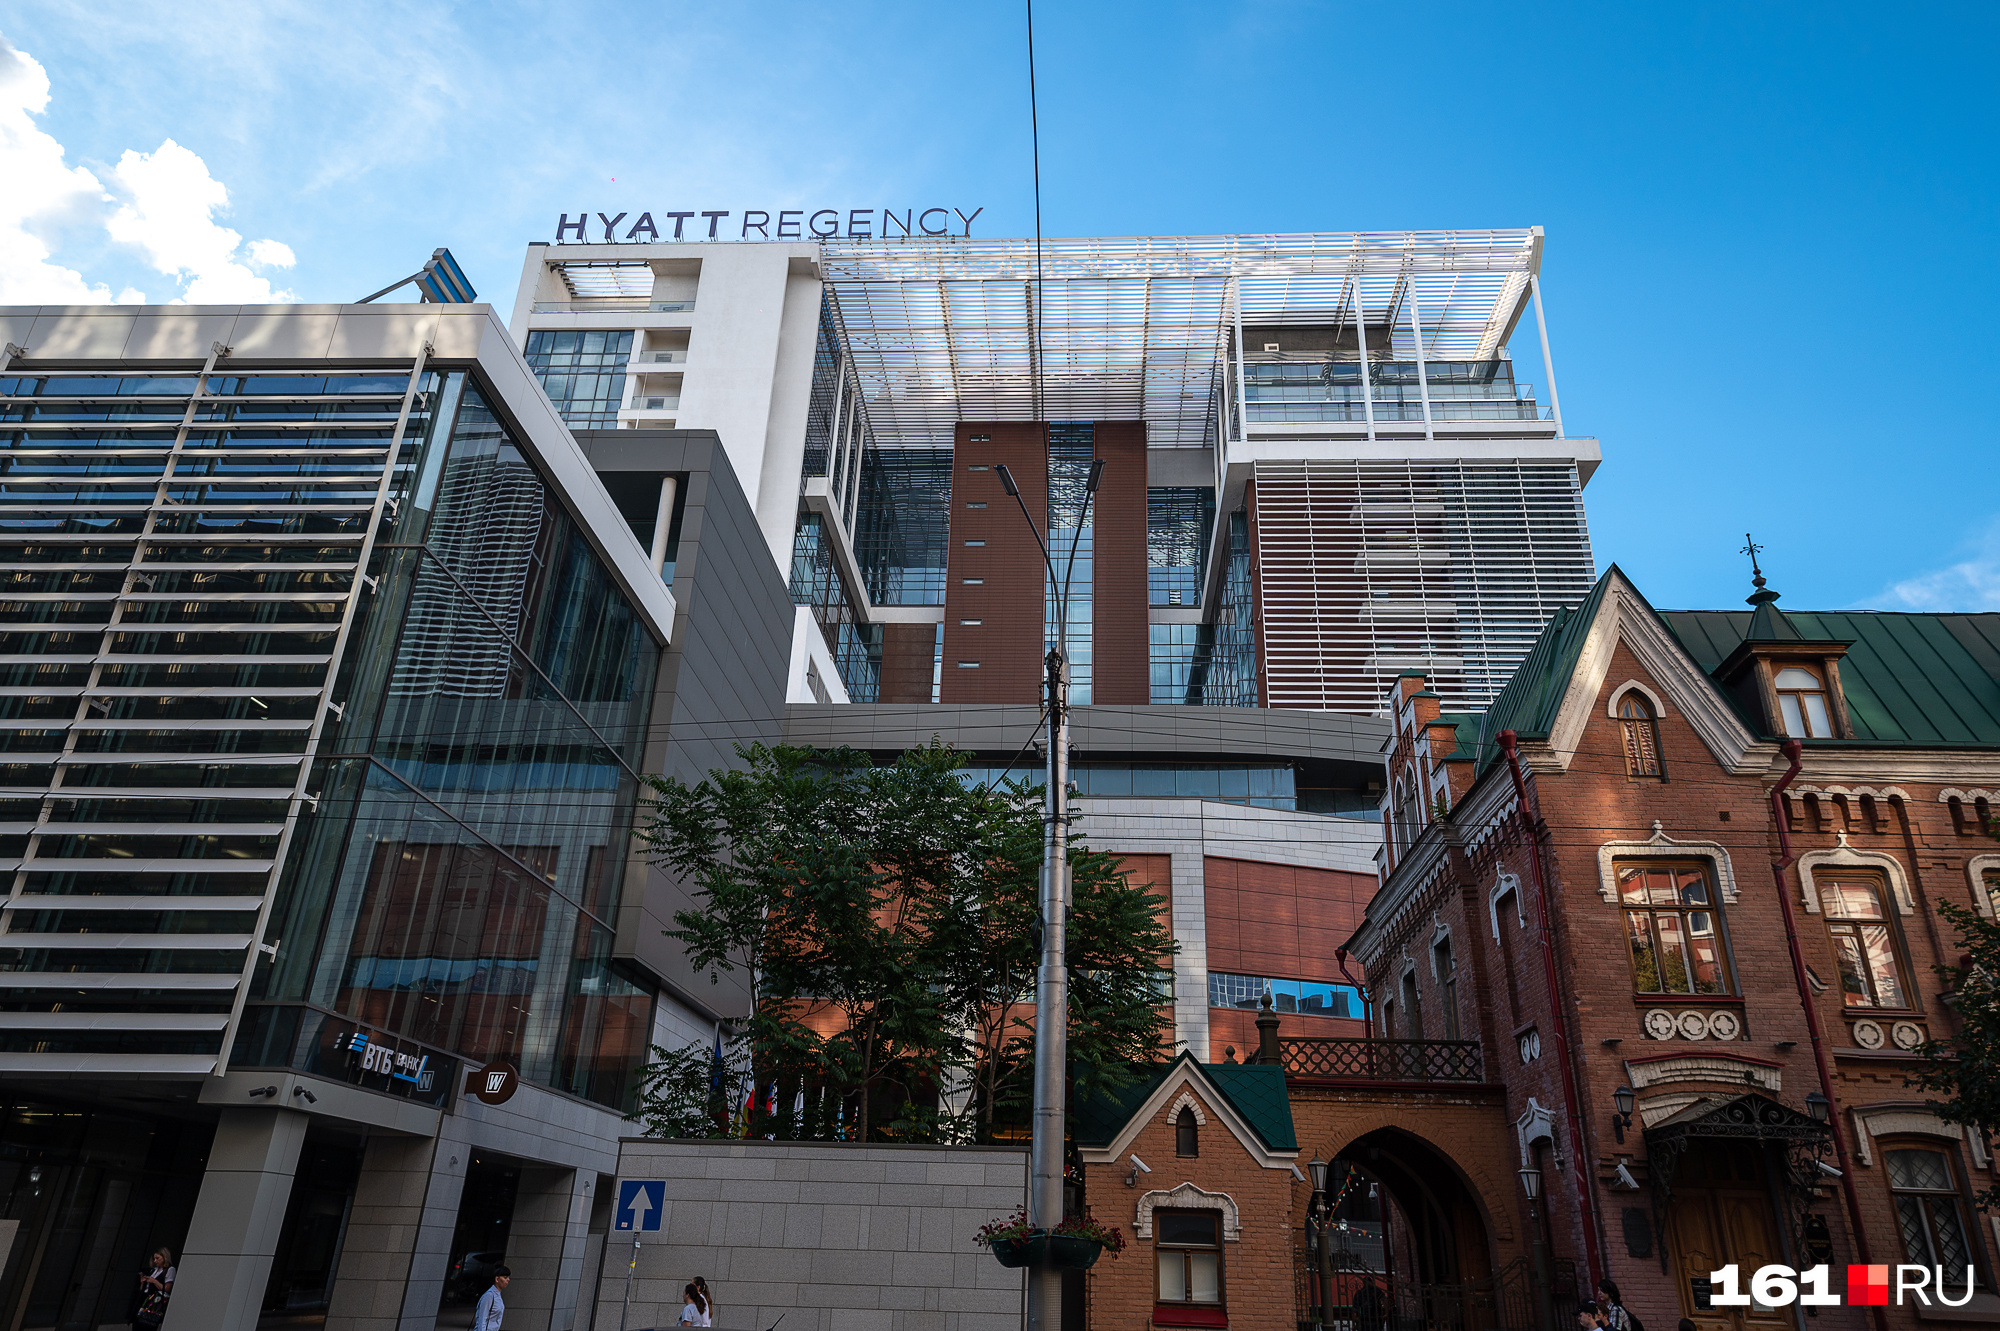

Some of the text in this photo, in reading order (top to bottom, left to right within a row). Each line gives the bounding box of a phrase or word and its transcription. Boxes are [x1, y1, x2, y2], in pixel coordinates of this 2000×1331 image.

[556, 207, 984, 240] HYATT REGENCY
[362, 1042, 420, 1075] ВТБ БАНК
[488, 1073, 503, 1091] W
